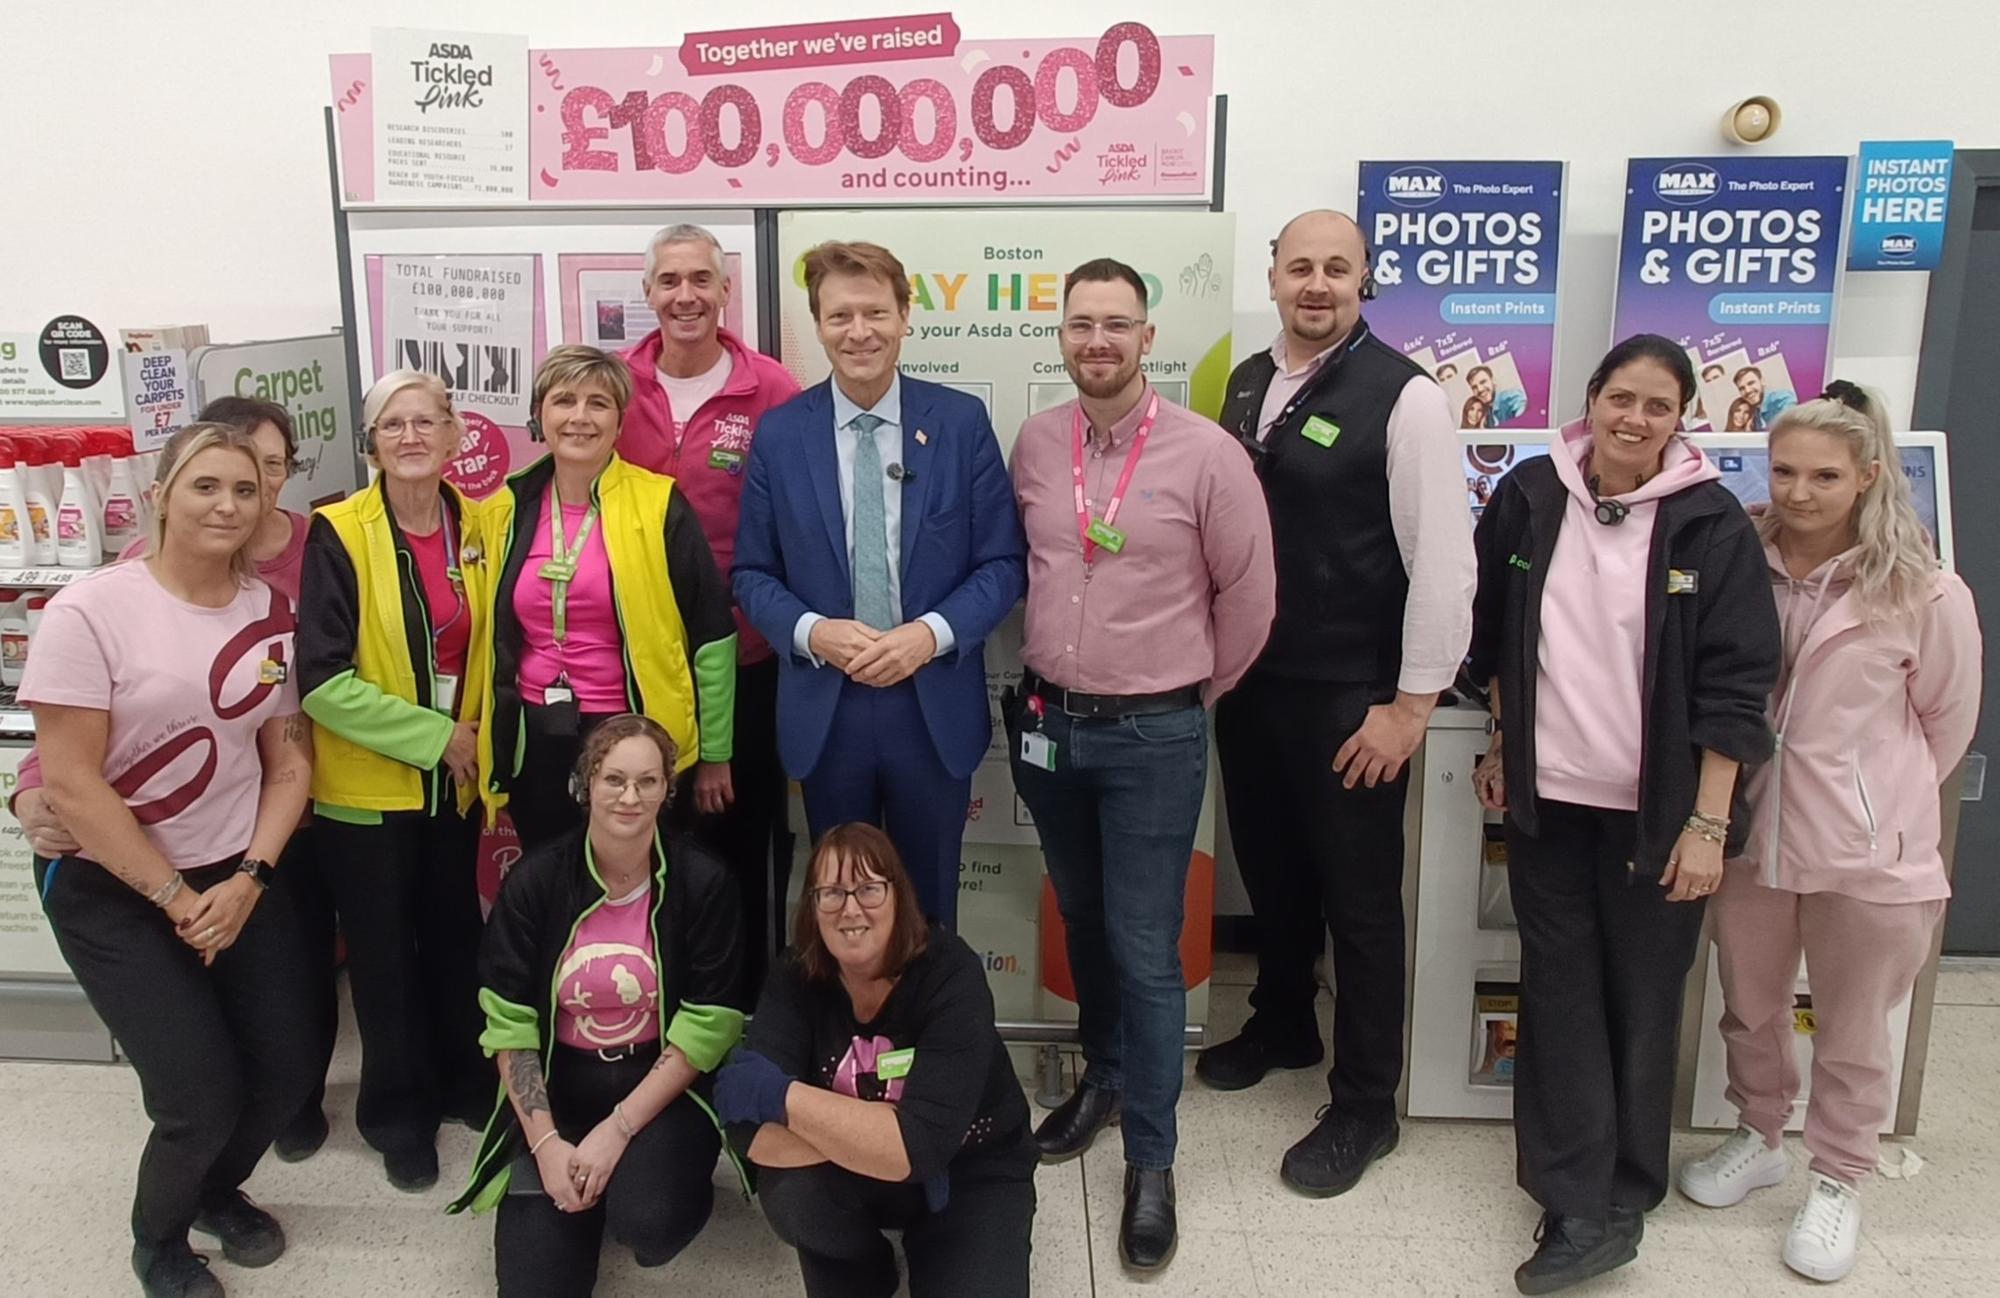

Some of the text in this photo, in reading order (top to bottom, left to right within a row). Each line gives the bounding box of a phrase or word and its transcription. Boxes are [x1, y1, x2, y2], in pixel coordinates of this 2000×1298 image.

[428, 42, 473, 60] ASDA
[696, 24, 943, 65] Together we've raised
[410, 60, 492, 86] Tickled
[561, 21, 1161, 174] £100,000,000
[1108, 143, 1135, 153] ASDA
[1096, 154, 1147, 168] Tickled
[1867, 158, 1949, 175] INSTANT
[841, 165, 1031, 191] and counting...
[1388, 176, 1533, 195] MAX The Photo Expert
[1659, 173, 1815, 192] MAX The Photo Expert
[1865, 177, 1947, 194] PHOTOS
[1861, 197, 1945, 224] HERE
[1374, 211, 1542, 246] PHOTOS
[1642, 209, 1821, 244] PHOTOS
[1882, 239, 1914, 249] MAX
[984, 246, 1043, 260] Boston
[396, 263, 522, 285] TOTAL FUNDRAISED
[1373, 250, 1540, 285] & GIFTS
[1639, 248, 1817, 284] & GIFTS
[412, 281, 505, 301] £100,000,000
[911, 273, 969, 311] AY
[1450, 301, 1545, 316] Instant Prints
[1720, 300, 1822, 315] Instant Prints
[50, 329, 92, 338] QR CODE
[57, 321, 84, 330] SCAN
[426, 321, 493, 334] YOUR SUPPORT!
[921, 325, 962, 340] your
[967, 323, 1013, 337] Asda
[1019, 323, 1060, 337] Com
[142, 355, 172, 369] DEEP
[902, 361, 1187, 375] nvolved Com otlight
[140, 367, 176, 381] CLEAN
[144, 379, 175, 392] YOUR
[234, 359, 324, 407] Carpet
[135, 389, 185, 406] CARPETS
[468, 392, 520, 406] CHECKOUT
[140, 401, 182, 413] FOR UNDER
[145, 428, 159, 437] PER
[971, 861, 1002, 875] find
